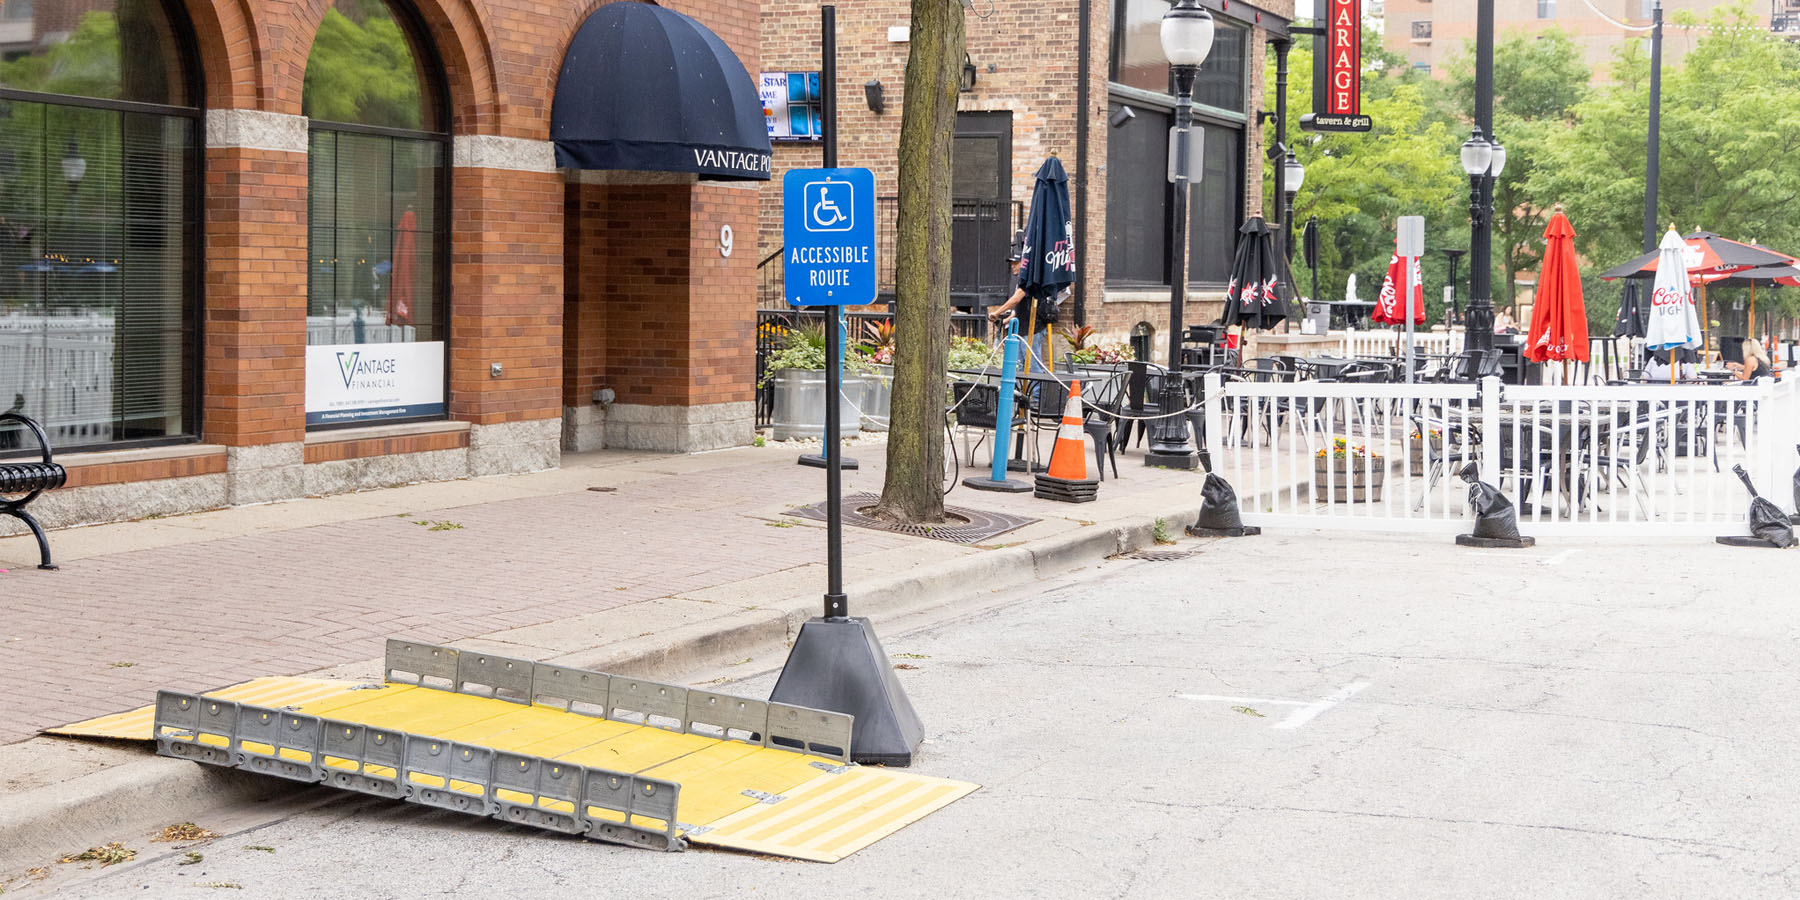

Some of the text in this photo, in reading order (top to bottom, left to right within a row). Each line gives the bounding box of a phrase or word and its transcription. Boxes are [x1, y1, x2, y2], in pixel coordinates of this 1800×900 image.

[1335, 0, 1353, 110] ARAGE
[760, 91, 777, 99] AME
[1316, 116, 1370, 127] tavern & grill
[694, 148, 759, 171] VANTAGE
[721, 224, 733, 257] 9
[791, 246, 869, 264] ACCESSIBLE
[810, 269, 850, 287] ROUTE
[336, 351, 396, 390] VANTAGE
[352, 379, 395, 390] FINANCIAL
